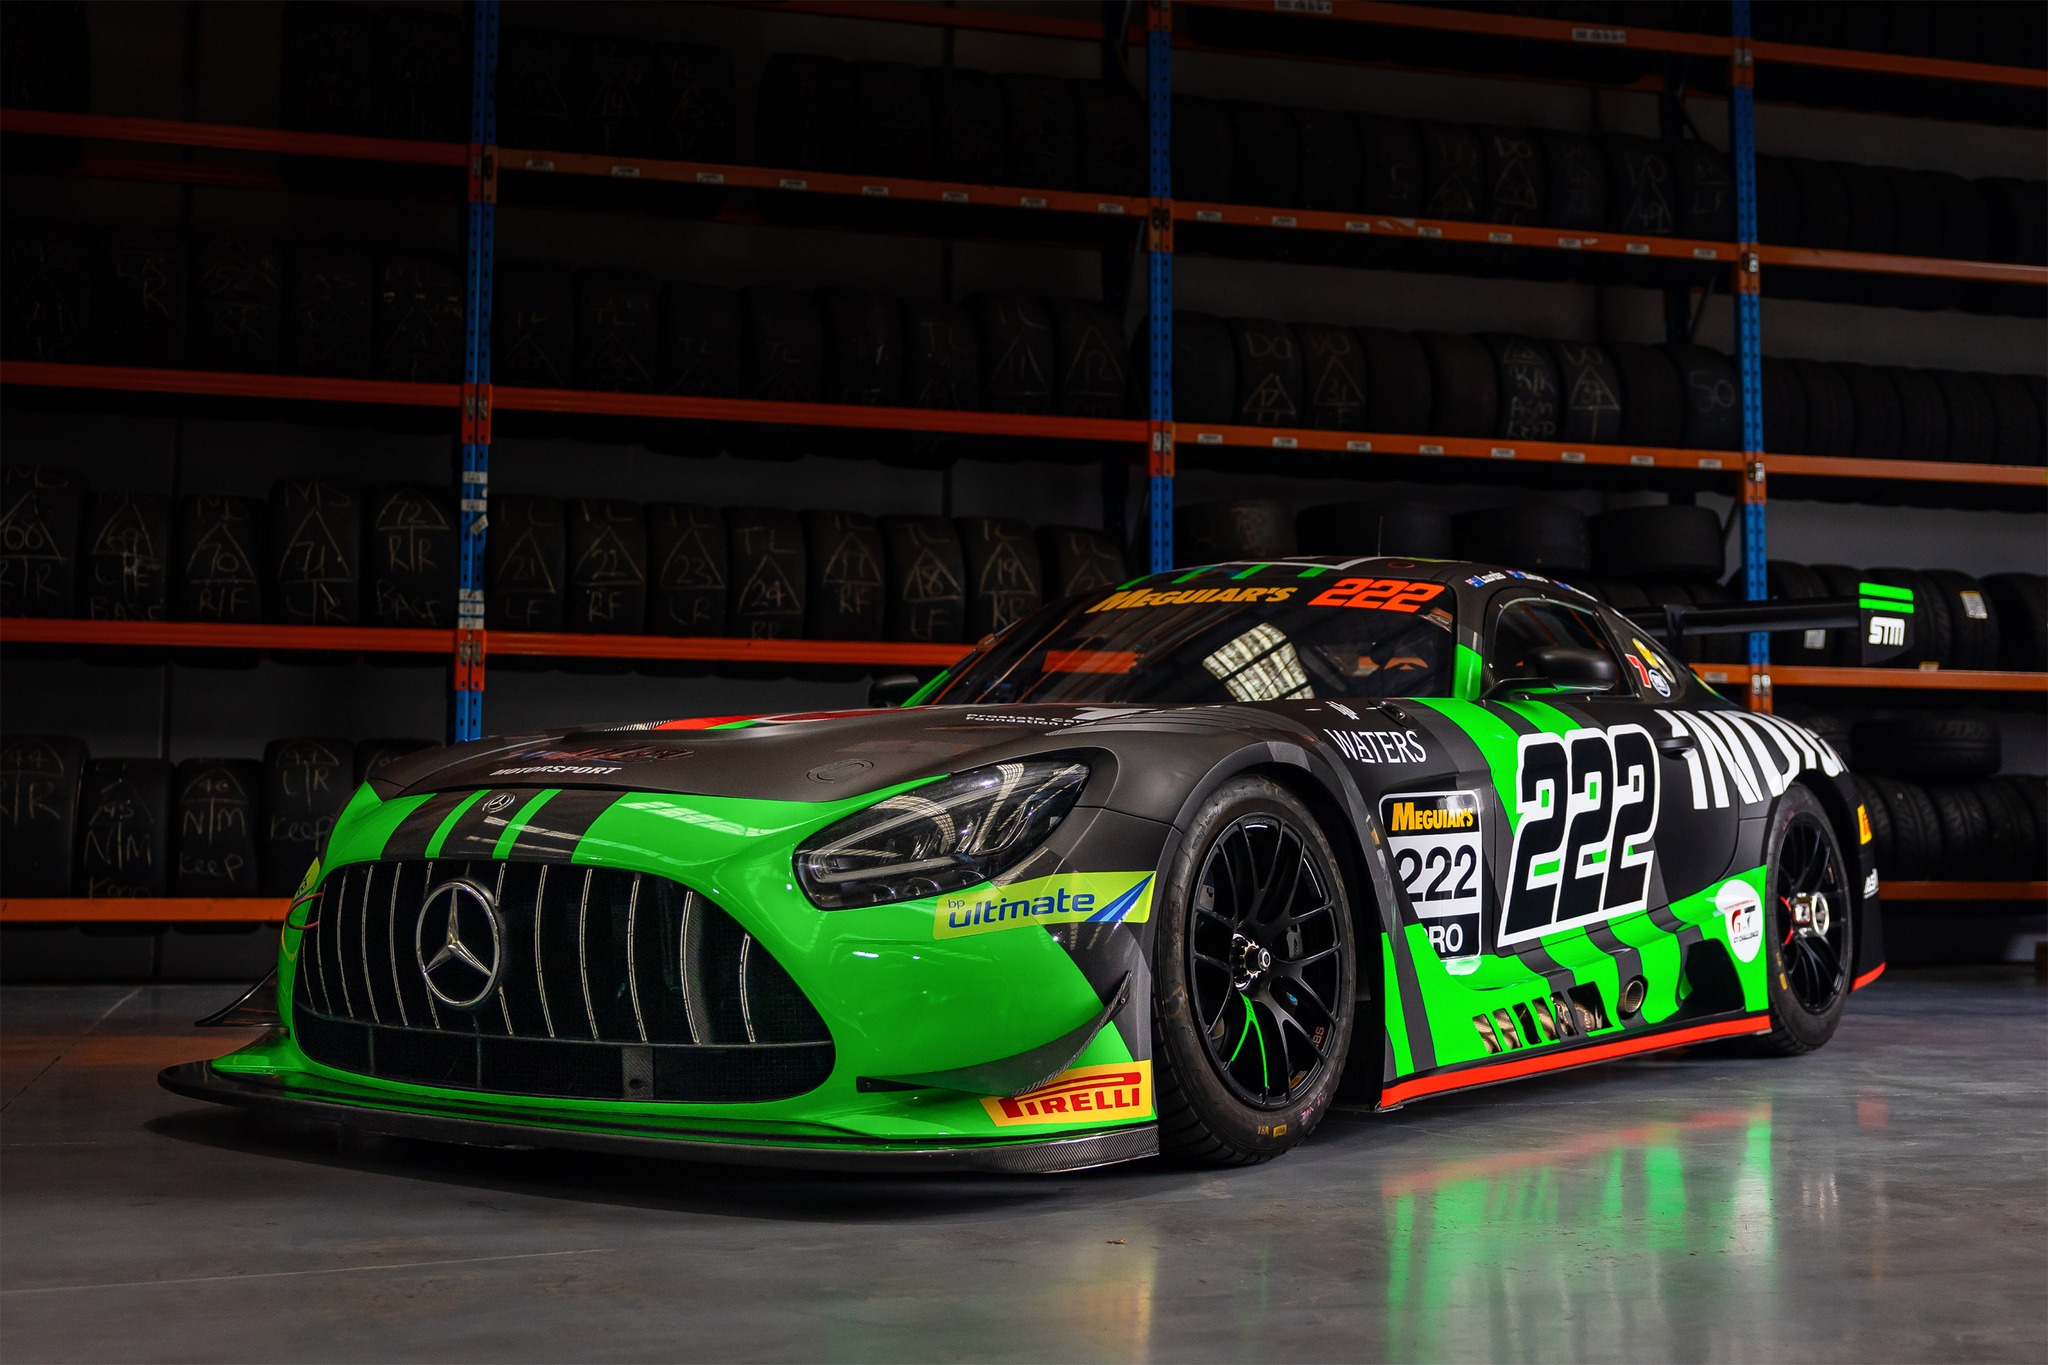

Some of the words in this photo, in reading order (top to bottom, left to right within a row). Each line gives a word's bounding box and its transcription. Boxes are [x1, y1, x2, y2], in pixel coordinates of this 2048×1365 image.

[1307, 578, 1445, 612] 222
[1323, 728, 1427, 764] WATERS
[1392, 802, 1473, 831] MEGUIAR'S
[1497, 724, 1660, 948] 222
[1395, 844, 1477, 903] 222
[948, 899, 965, 909] bp
[949, 888, 1095, 928] ultimate
[1422, 923, 1463, 952] RO
[998, 1072, 1142, 1119] PIRELLI
